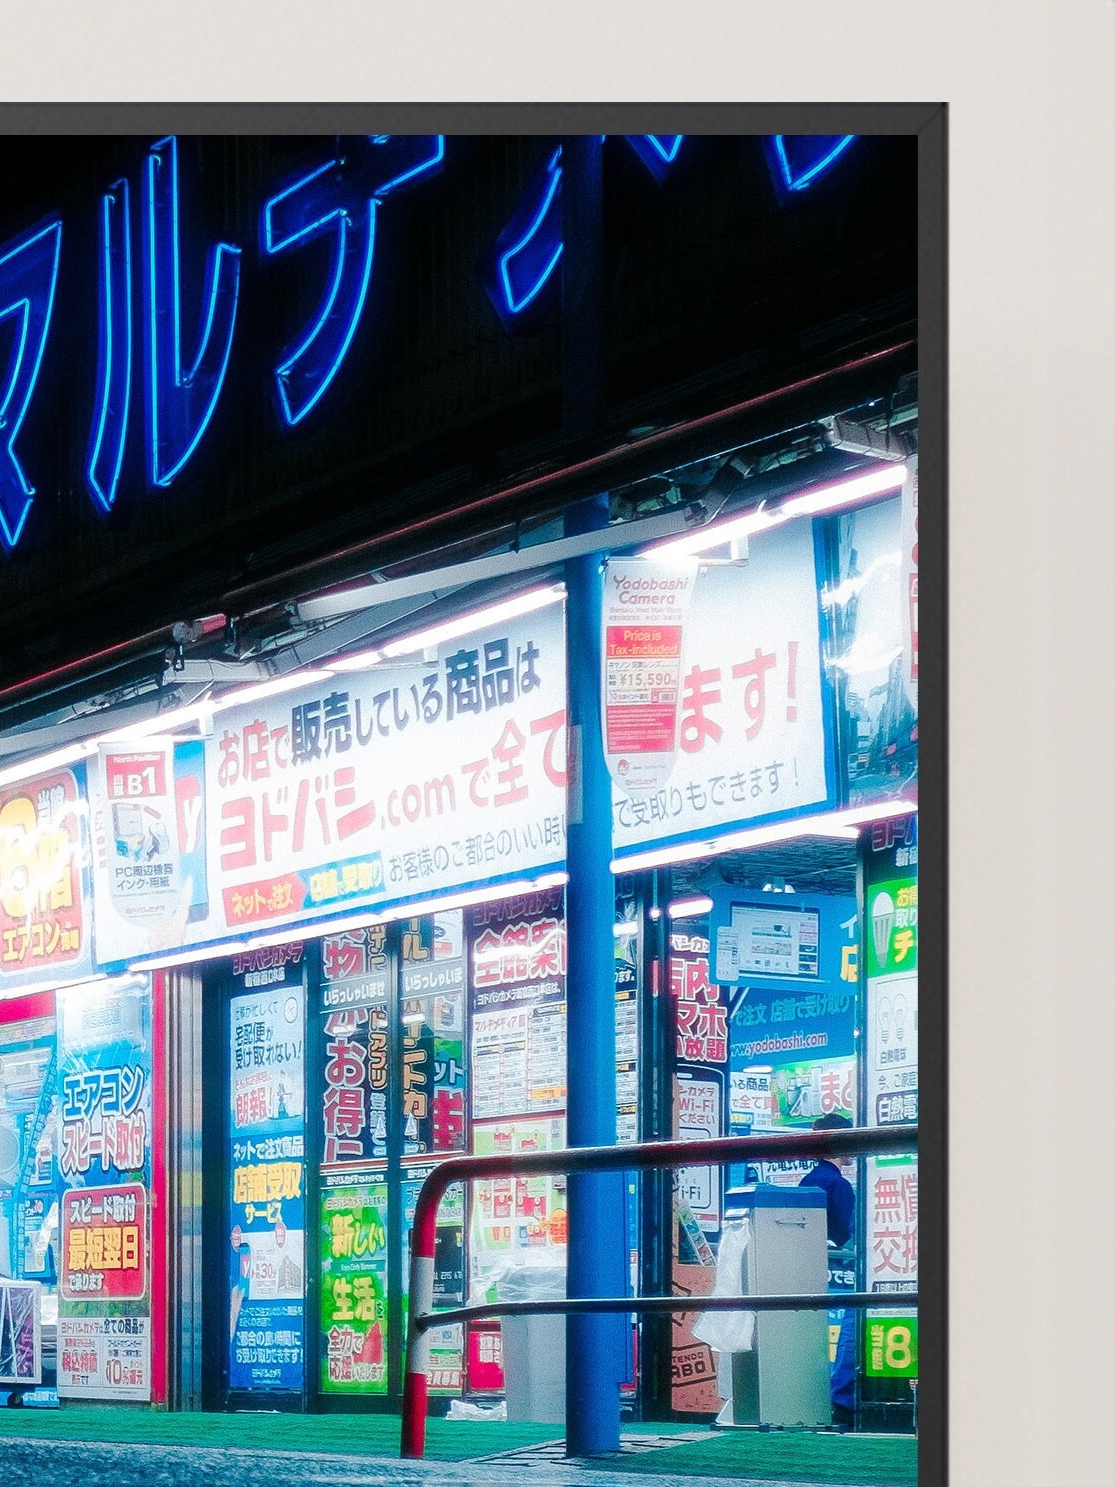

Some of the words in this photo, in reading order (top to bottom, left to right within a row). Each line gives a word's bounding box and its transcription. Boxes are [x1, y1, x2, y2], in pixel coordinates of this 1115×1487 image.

[613, 575, 689, 591] Yodobashi
[619, 590, 676, 605] Camera
[623, 630, 651, 642] Price
[652, 630, 662, 641] is
[610, 643, 678, 656] Tax-included
[218, 636, 541, 788] お店で販売している商品は
[220, 708, 568, 872] ヨドバシ.comで全て
[115, 863, 174, 878] PC周辺機器
[473, 917, 567, 989] 全館案
[323, 980, 386, 1007] いらっしゃいませ
[677, 1002, 727, 1037] マホ
[235, 1021, 274, 1047] 宅配便が
[235, 1040, 303, 1071] 受け取れない!
[63, 1064, 145, 1121] エアコン
[678, 1086, 716, 1098] シカメラ
[678, 1100, 715, 1113] Wi-Fi
[61, 1110, 147, 1173] スピード取付
[681, 1186, 701, 1201] i-Fi
[69, 1193, 136, 1224] スピード取付
[244, 1201, 283, 1225] サービス
[67, 1226, 139, 1270] 最短翌日
[331, 1212, 386, 1260] 新しい
[671, 1360, 706, 1379] ABO
[672, 1351, 704, 1364] TENDO
